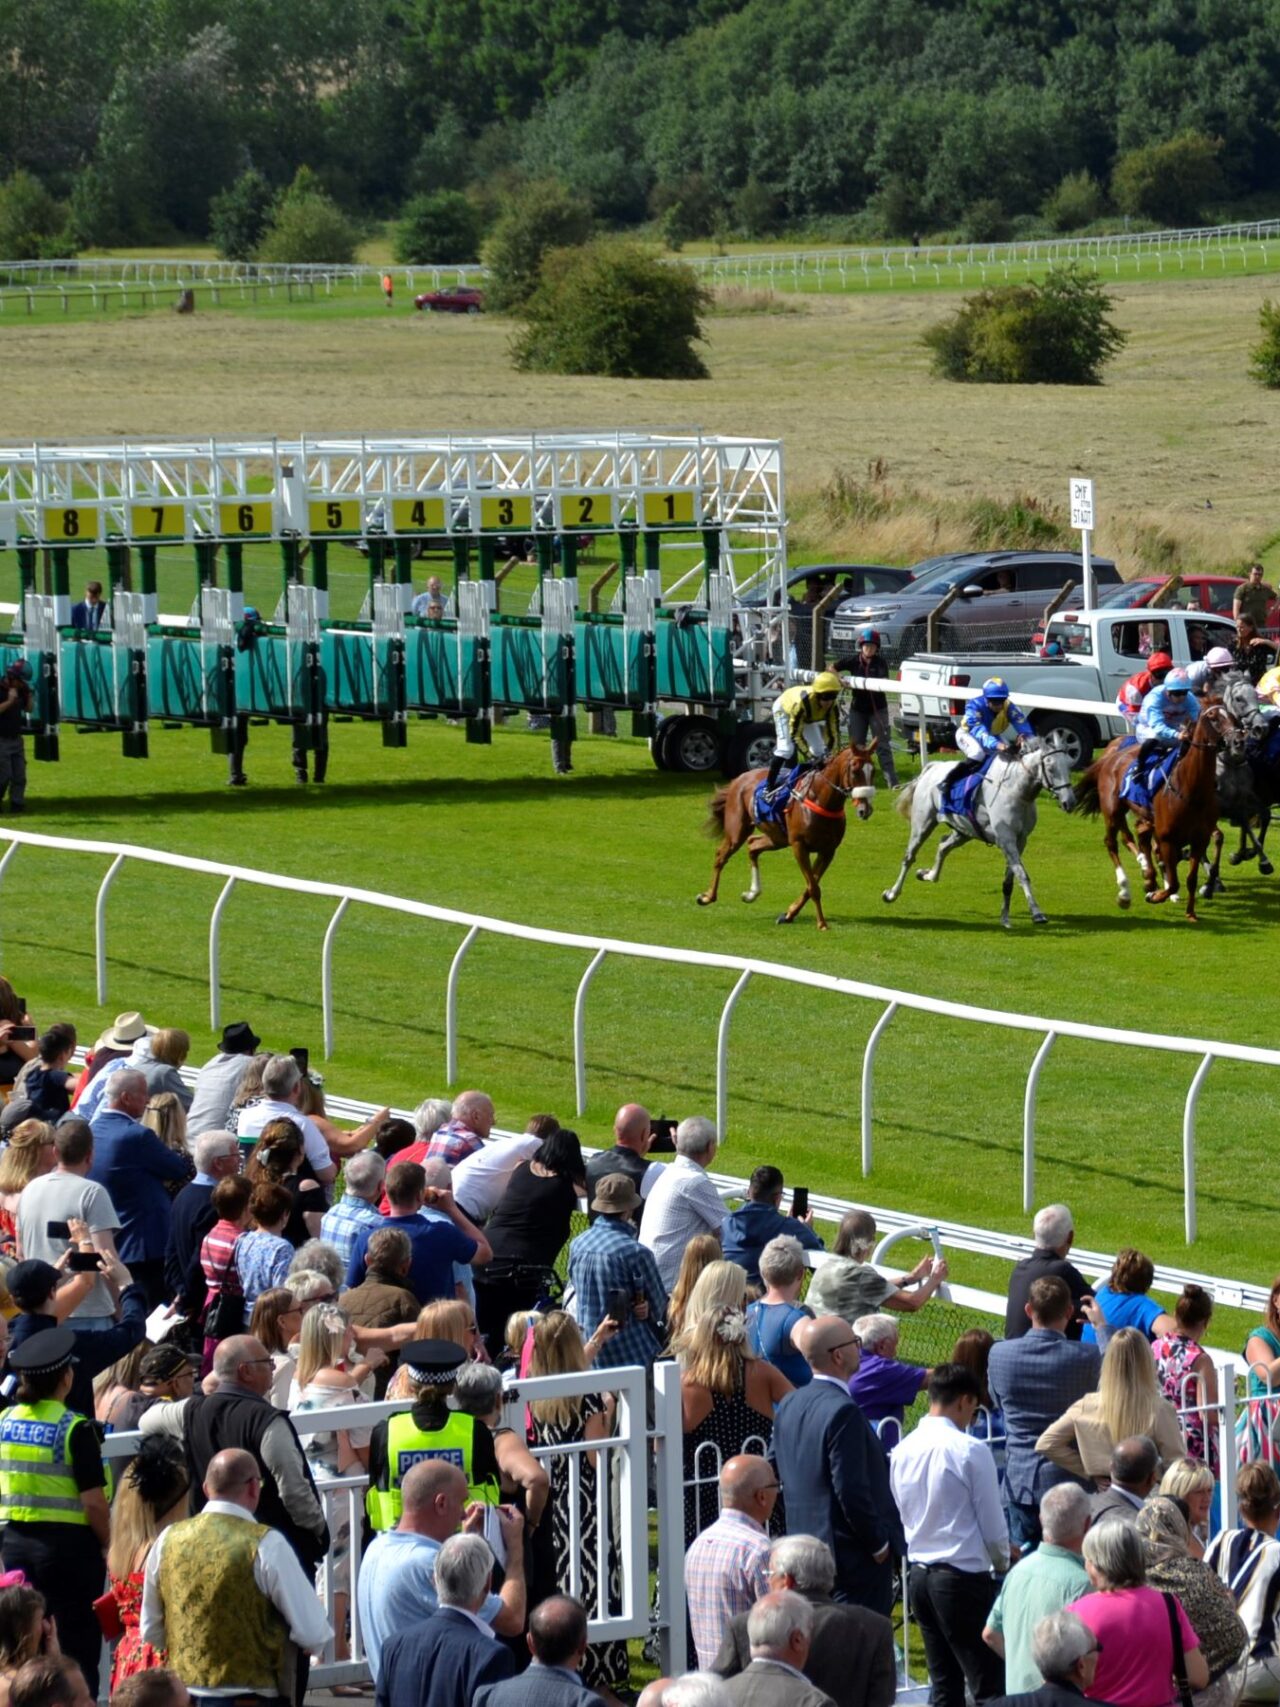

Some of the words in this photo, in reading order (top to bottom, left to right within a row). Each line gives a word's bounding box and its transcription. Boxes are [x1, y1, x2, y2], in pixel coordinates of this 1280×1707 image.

[150, 507, 164, 533] 7
[238, 504, 253, 531] 6
[327, 502, 343, 529] 5
[411, 500, 426, 527] 4
[498, 498, 514, 525] 3
[578, 496, 593, 523] 2
[664, 494, 675, 520] 1
[63, 509, 78, 536] 8
[2, 1421, 56, 1444] POLICE
